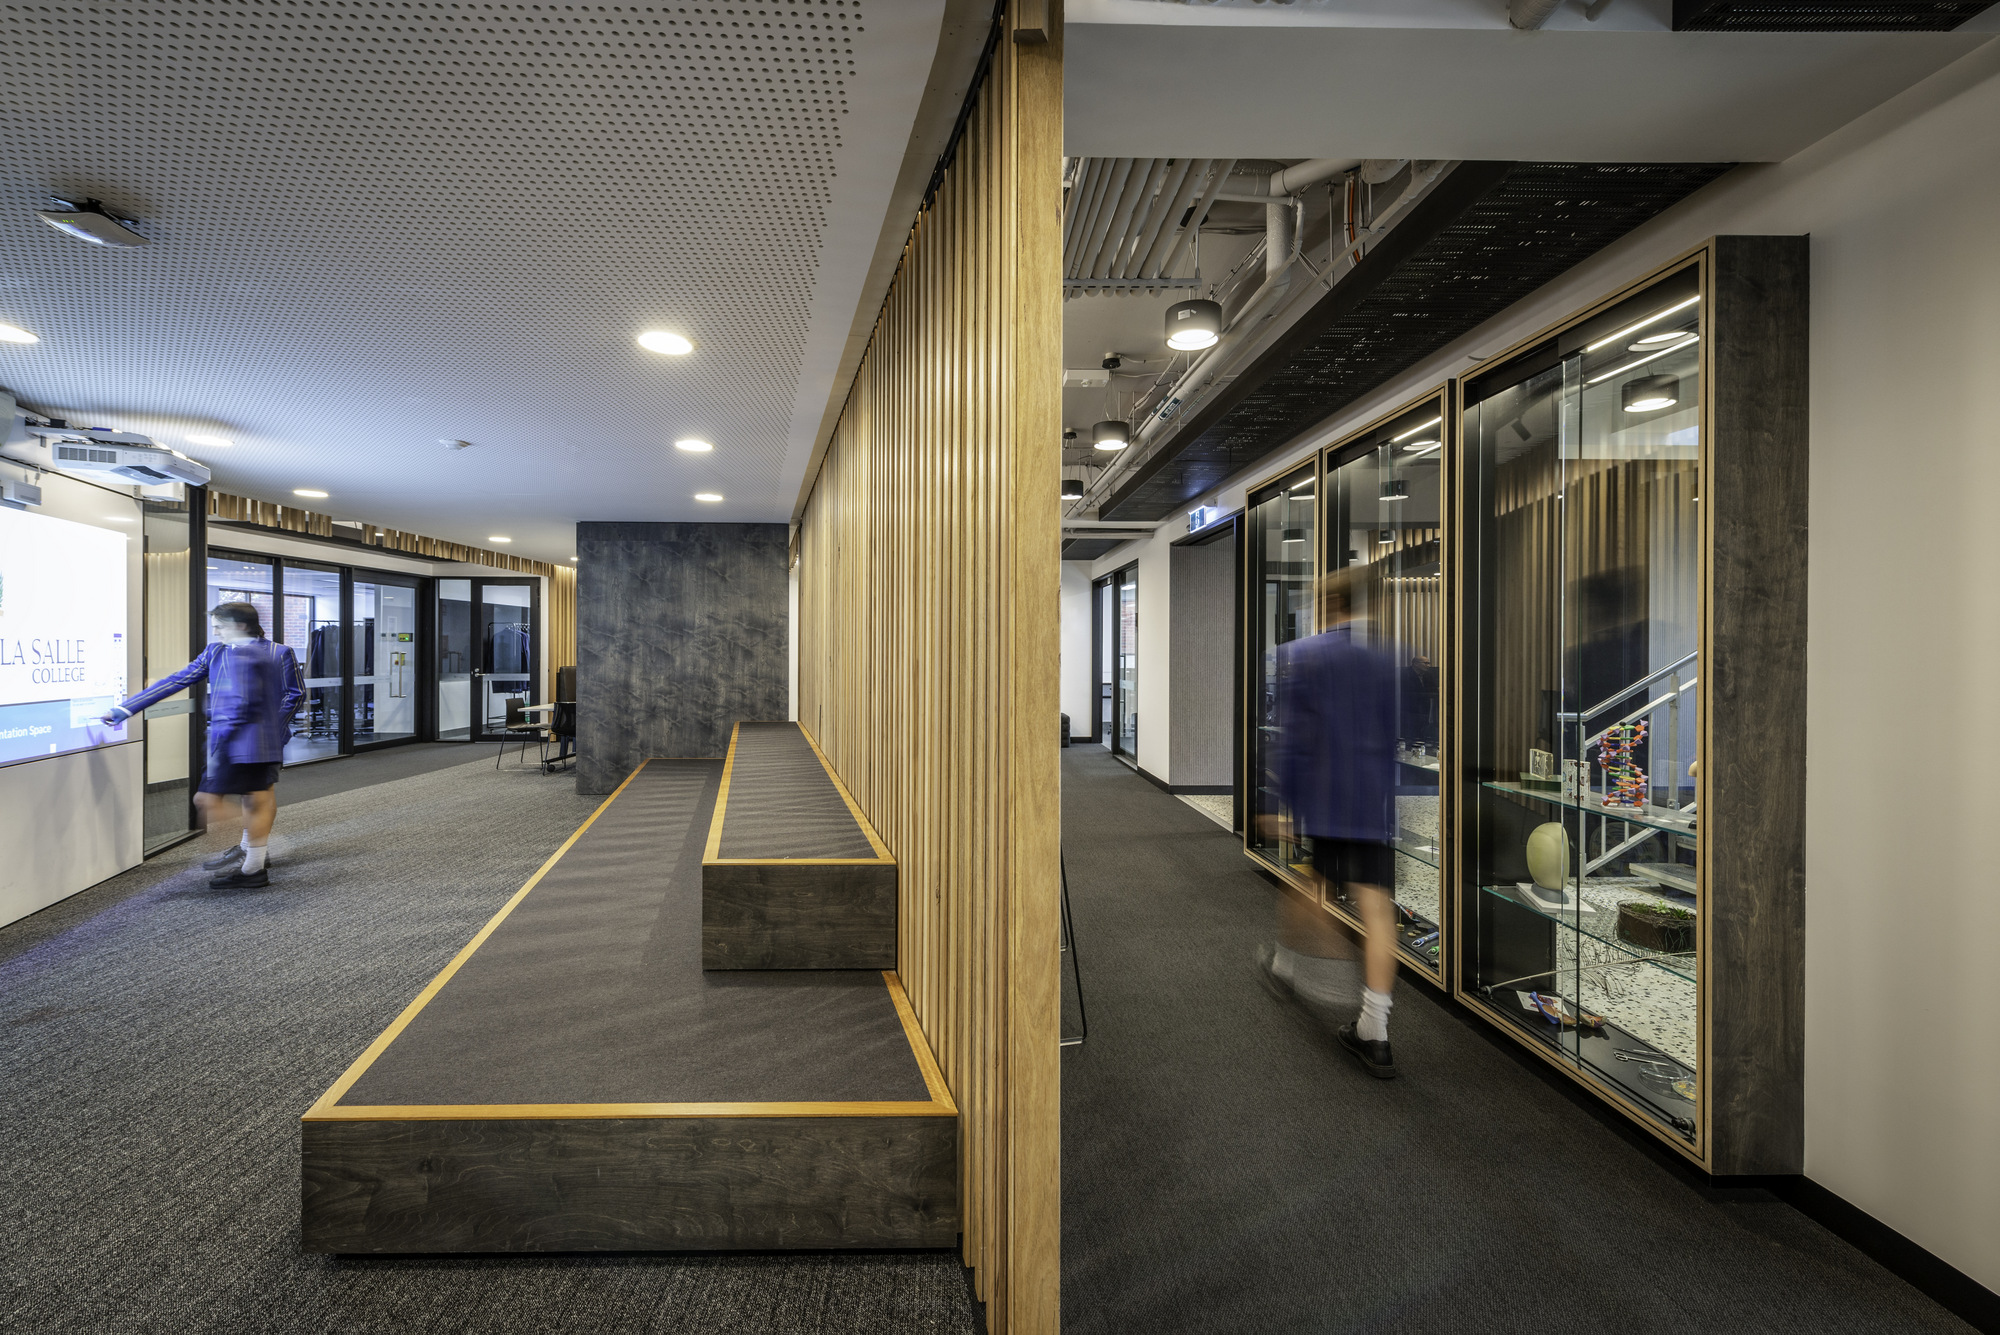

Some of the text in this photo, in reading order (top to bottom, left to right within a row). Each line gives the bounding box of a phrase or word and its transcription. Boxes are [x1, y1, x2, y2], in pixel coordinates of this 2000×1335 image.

[0, 638, 85, 665] LA SALLE
[32, 667, 85, 684] COLLEGE
[29, 725, 52, 737] Space
